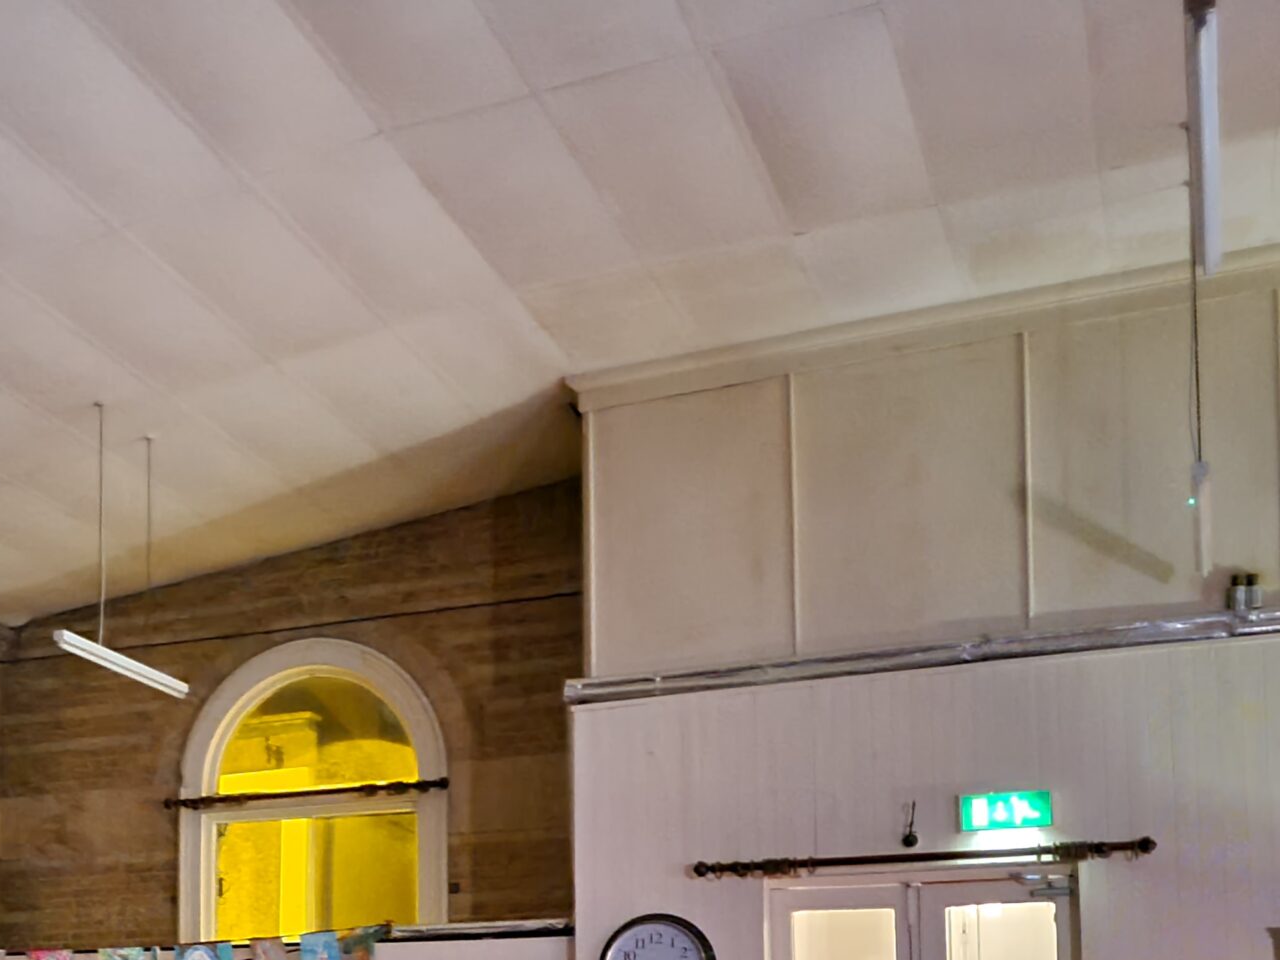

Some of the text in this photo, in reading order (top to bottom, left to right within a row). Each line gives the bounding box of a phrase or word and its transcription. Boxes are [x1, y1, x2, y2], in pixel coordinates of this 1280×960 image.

[635, 938, 645, 949] 11
[649, 932, 663, 944] 12
[623, 951, 636, 960] 10
[680, 946, 688, 958] 2
